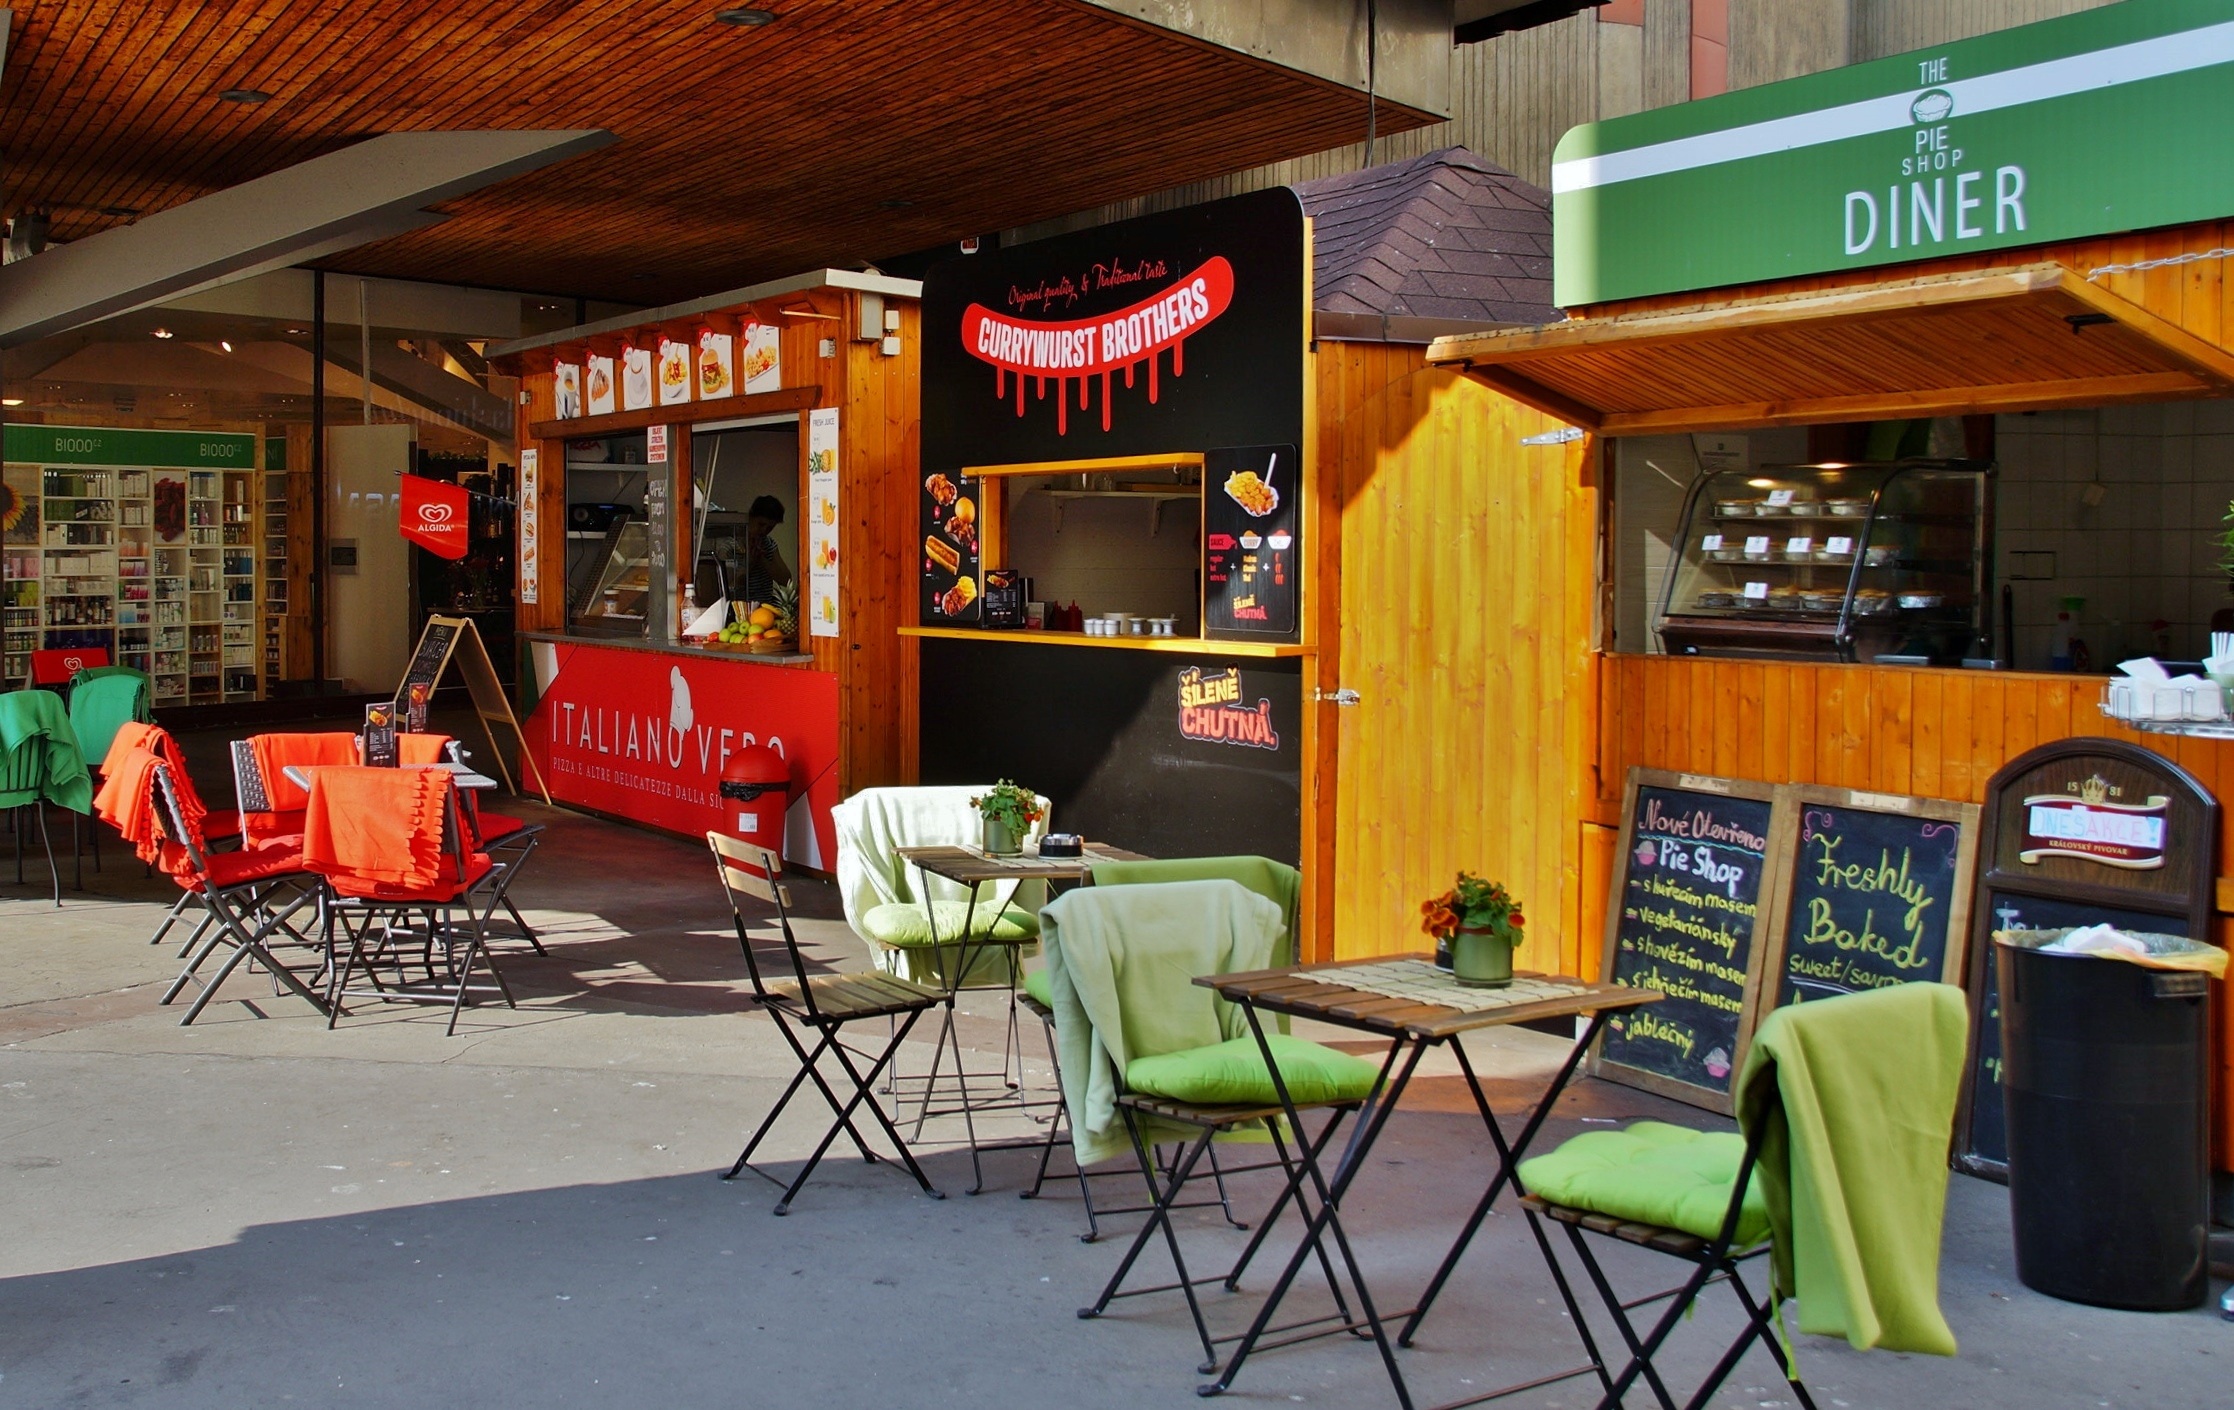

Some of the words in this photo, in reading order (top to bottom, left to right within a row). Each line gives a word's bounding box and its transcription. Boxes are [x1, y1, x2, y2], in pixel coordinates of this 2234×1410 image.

[1918, 57, 1948, 85] THE
[1915, 125, 1948, 154] PIE
[1902, 149, 1963, 176] SHOP
[1845, 165, 2027, 255] DINER
[1008, 280, 1044, 312] Original
[1043, 276, 1078, 312] quality
[1081, 273, 1090, 296] &
[1092, 257, 1145, 290] Traditional
[1145, 259, 1168, 280] taste
[978, 317, 1097, 369] CURRYWURST
[1102, 277, 1209, 363] BROTHERS
[418, 524, 452, 532] ALGIDA
[1181, 667, 1239, 708] ŠÍLENĚ
[553, 700, 683, 768] ITALIANO
[697, 724, 785, 775] VE
[553, 756, 575, 774] PIZZA
[578, 764, 583, 776] E
[586, 765, 611, 782] ALTRE
[614, 770, 672, 797] DELICATEZZE
[675, 785, 706, 805] DALLA
[2067, 782, 2078, 792] 15
[2109, 786, 2121, 797] 81
[1638, 799, 1690, 837] Nové
[2049, 840, 2091, 851] KRÁLOVSKÝ
[2093, 845, 2128, 856] PIVOVAR
[1660, 840, 1689, 871] Pie
[1692, 845, 1743, 898] Shop
[1810, 832, 1935, 930] Freshly
[1704, 893, 1757, 918] masem
[1803, 897, 1928, 969] Baked
[1699, 989, 1743, 1013] masem
